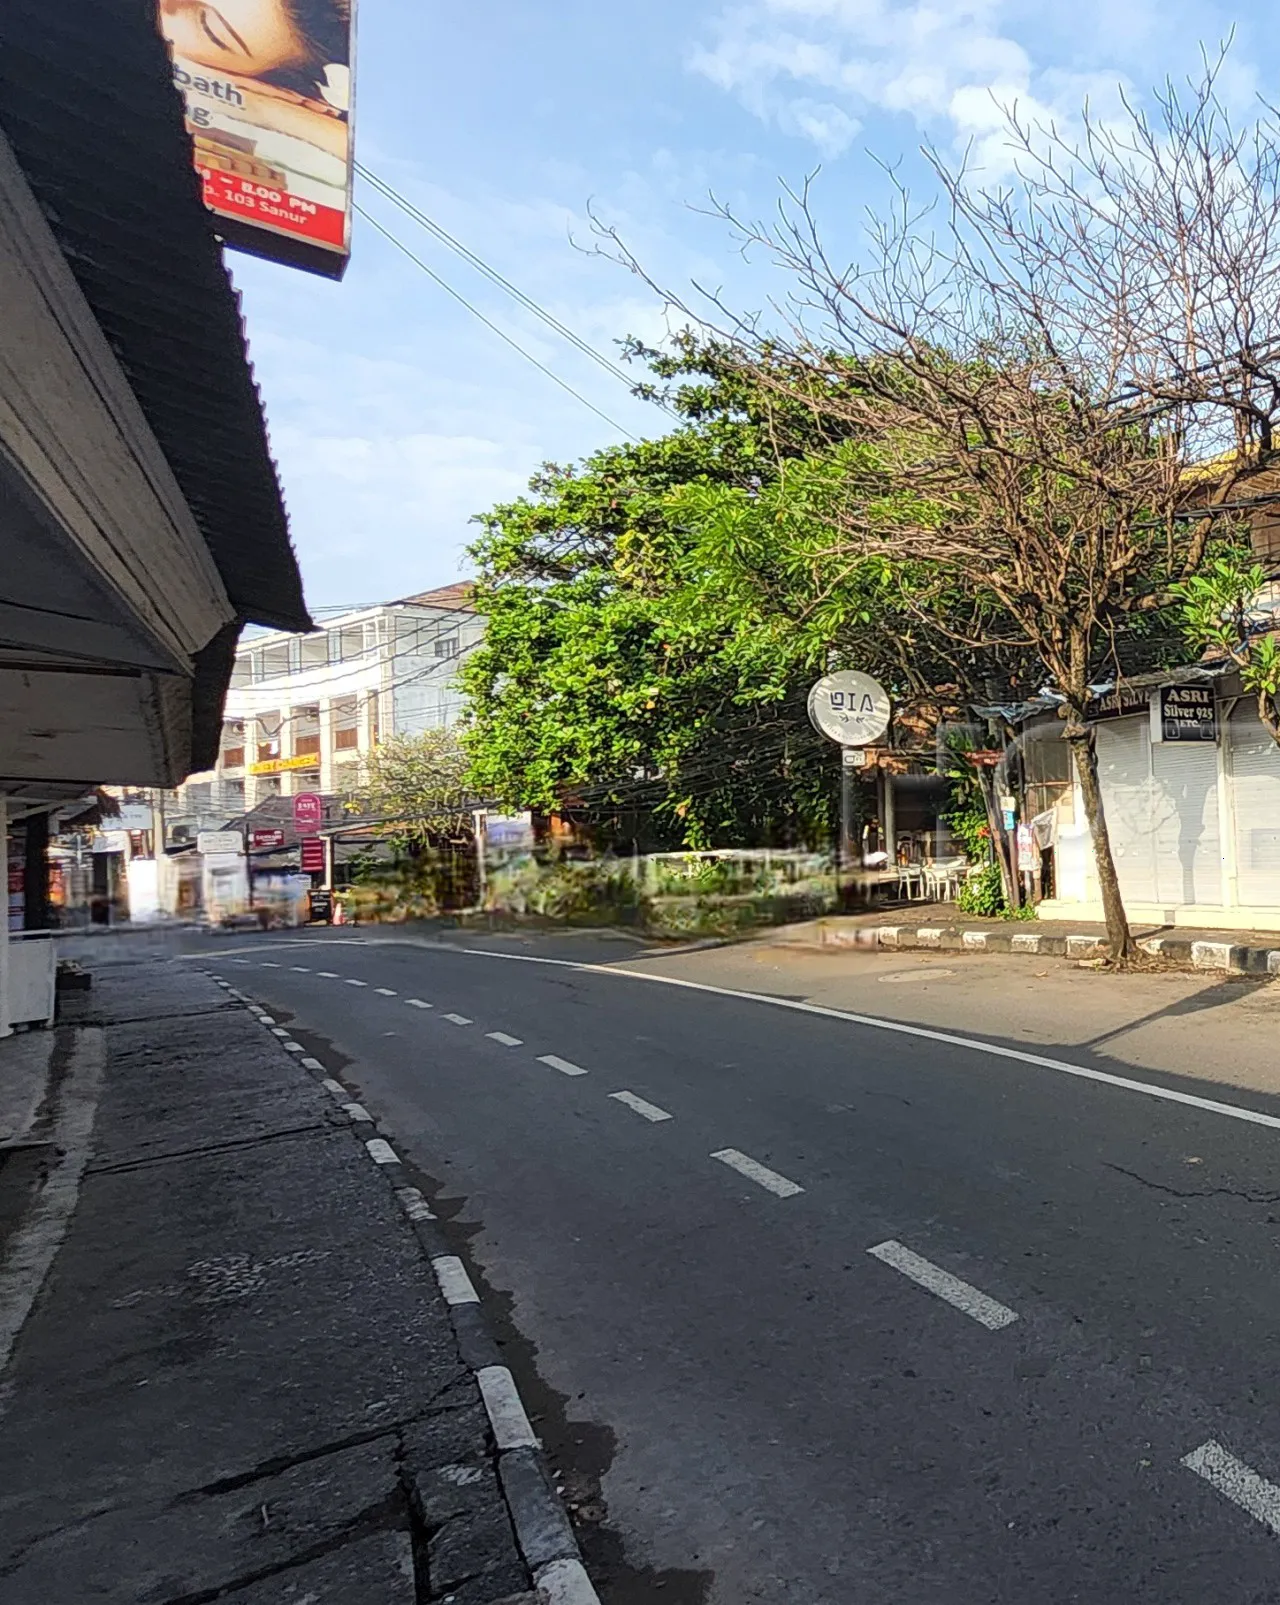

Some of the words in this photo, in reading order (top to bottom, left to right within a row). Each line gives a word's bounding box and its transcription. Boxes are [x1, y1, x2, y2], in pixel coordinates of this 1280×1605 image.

[224, 189, 255, 208] 103
[260, 201, 307, 224] Sanur
[289, 197, 317, 215] PM
[1167, 688, 1209, 703] ASRI
[1164, 704, 1195, 718] Silver
[1196, 707, 1213, 720] 925
